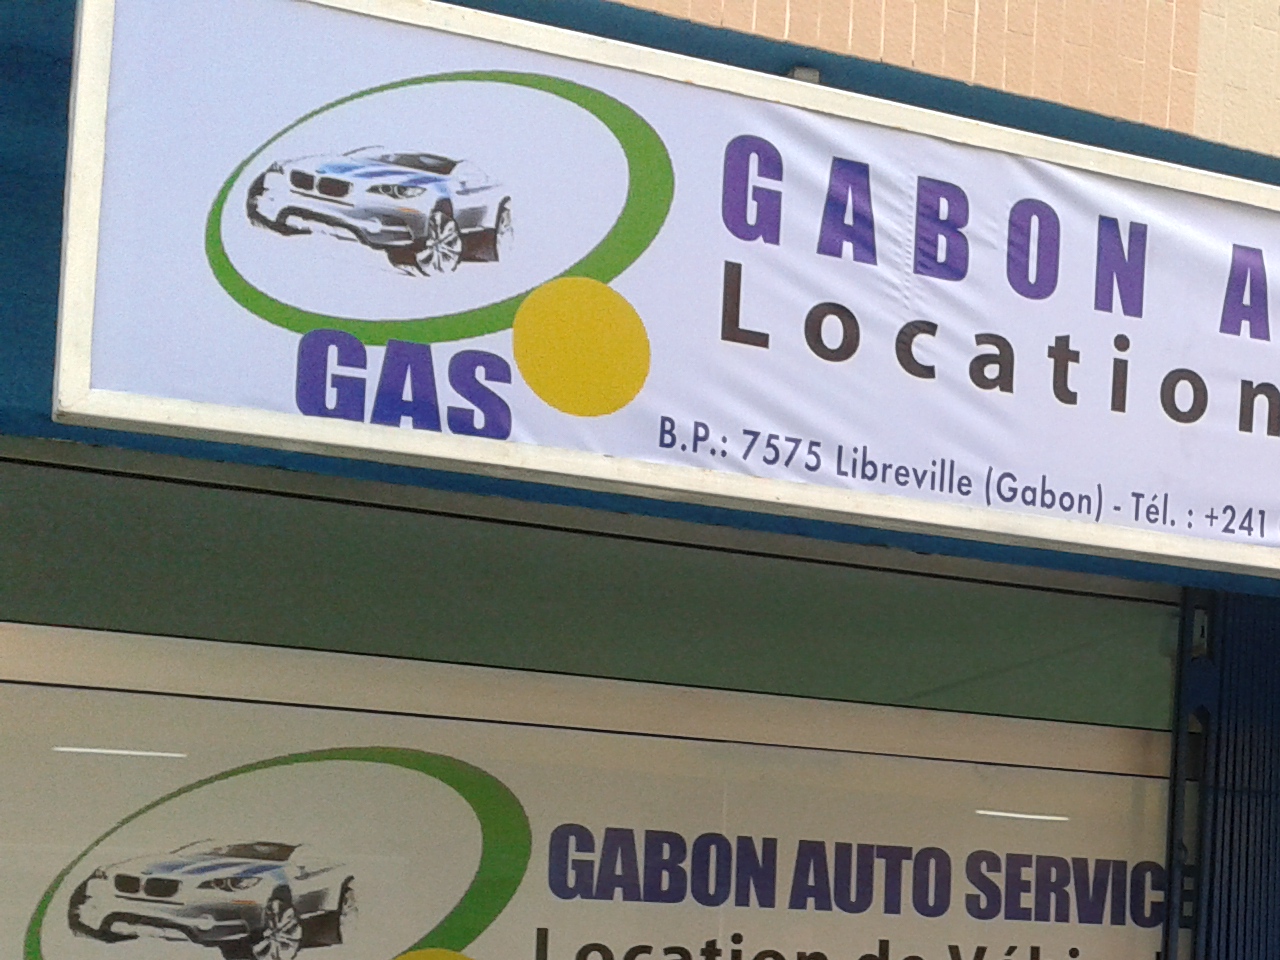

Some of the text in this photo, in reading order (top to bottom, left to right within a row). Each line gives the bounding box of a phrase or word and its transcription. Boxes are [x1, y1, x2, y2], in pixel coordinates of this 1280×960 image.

[721, 134, 1147, 318] GABON
[295, 328, 512, 440] GAS
[741, 429, 822, 472] 7575
[836, 445, 972, 496] Libreville
[985, 466, 1102, 522] (Gabon)
[1204, 504, 1266, 537] +241
[547, 823, 777, 910] GABON
[788, 839, 951, 918] AUTO
